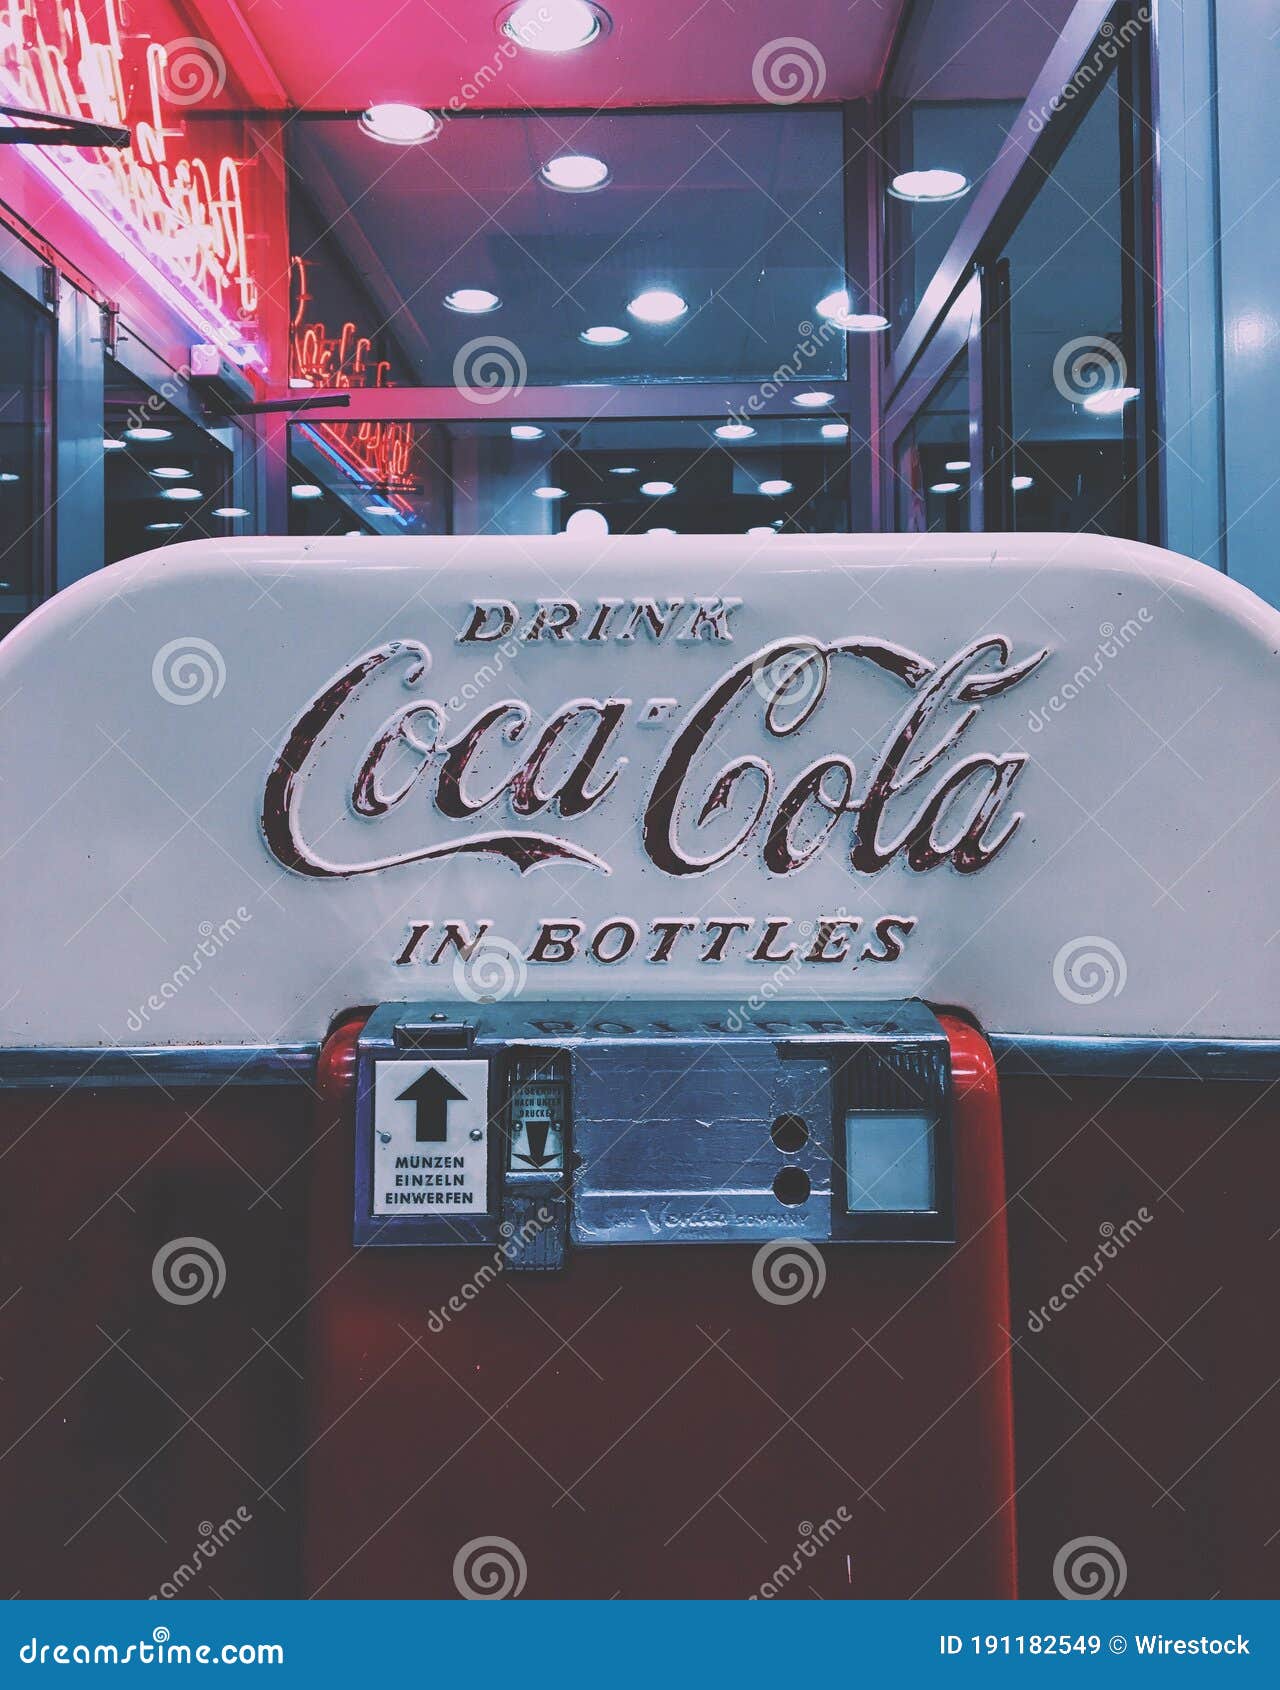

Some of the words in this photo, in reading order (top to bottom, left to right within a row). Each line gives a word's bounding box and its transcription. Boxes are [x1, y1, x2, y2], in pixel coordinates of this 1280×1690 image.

[455, 597, 743, 642] DRINK
[262, 636, 1051, 879] Coca-Cola
[395, 918, 493, 965] IN
[524, 917, 918, 964] BOTTLES
[395, 1156, 464, 1168] MÜNZEN
[395, 1174, 464, 1186] EINZELN
[385, 1192, 473, 1204] EINWERFEN
